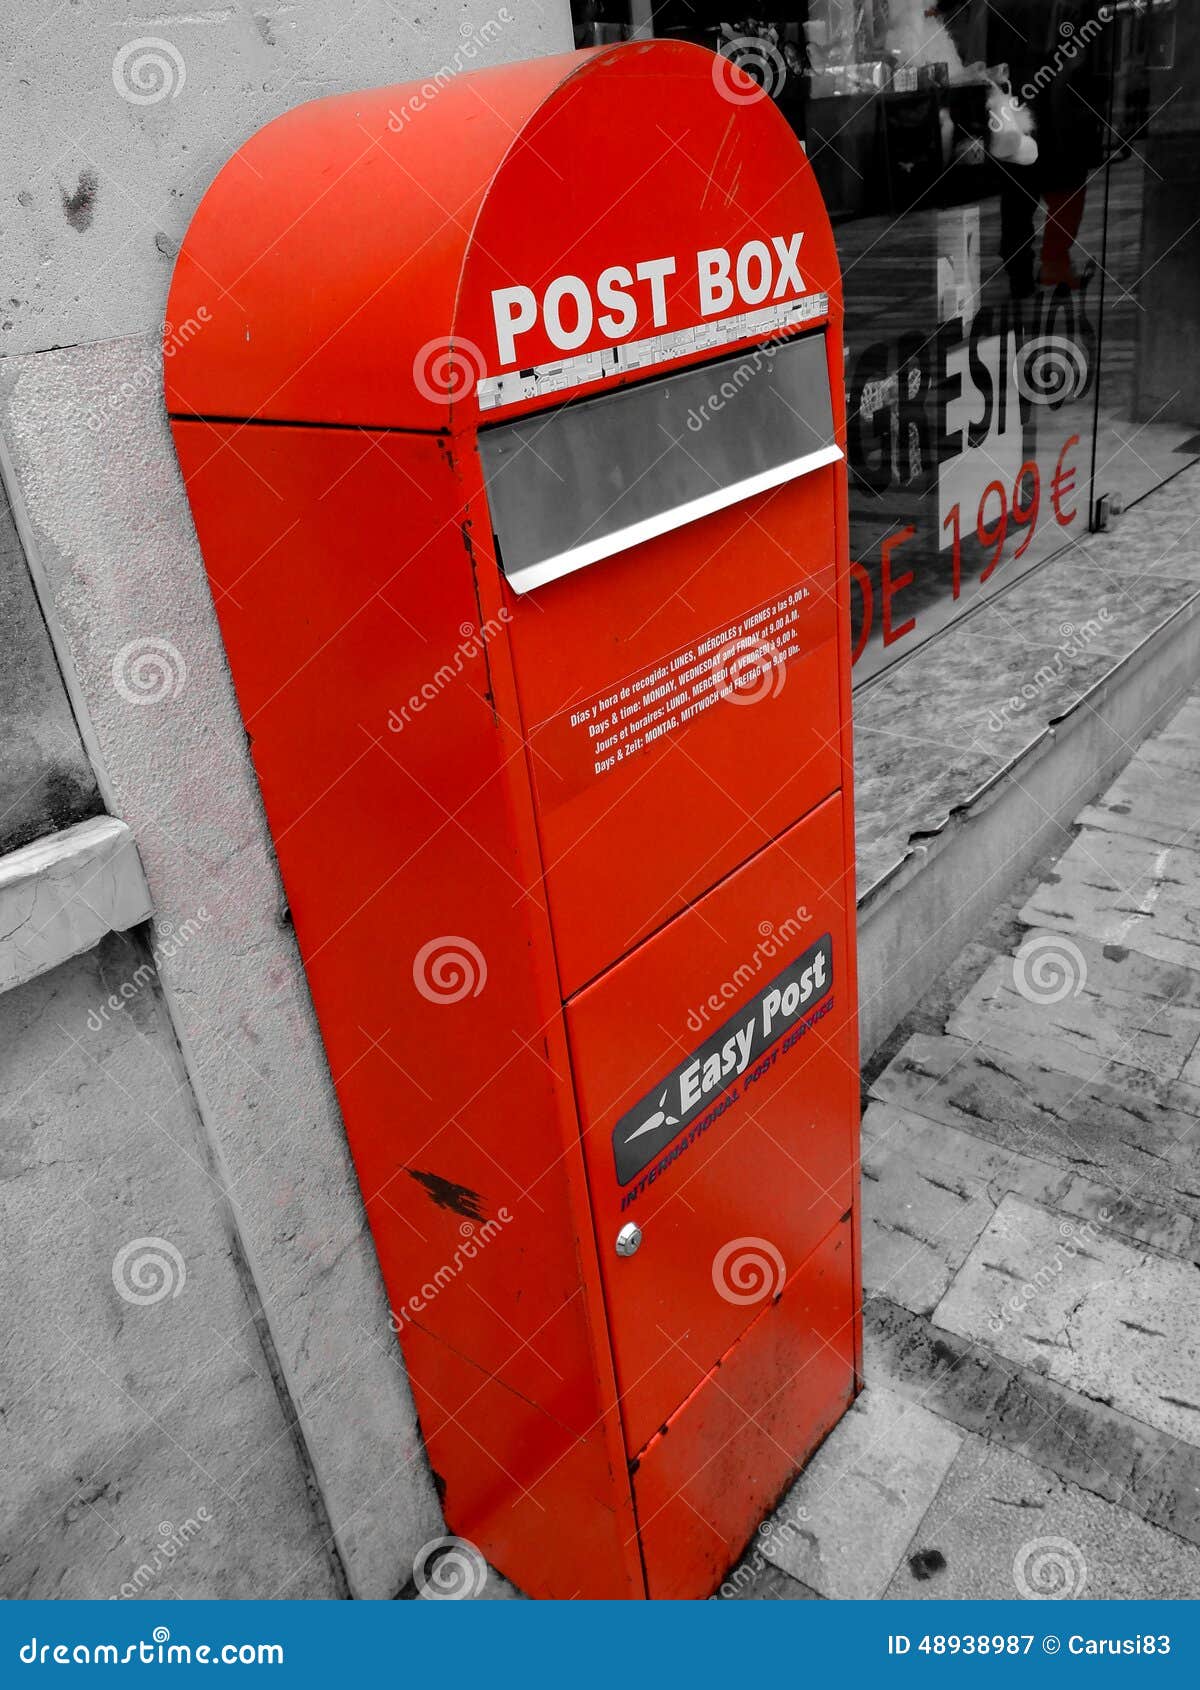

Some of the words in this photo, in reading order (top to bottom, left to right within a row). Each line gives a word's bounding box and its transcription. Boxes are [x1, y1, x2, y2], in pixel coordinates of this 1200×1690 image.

[491, 256, 676, 365] POST
[697, 232, 807, 316] BOX
[943, 434, 1081, 601] 199€
[570, 710, 590, 727] Días
[592, 705, 597, 718] y
[599, 694, 618, 712] hora
[620, 687, 631, 700] de
[632, 666, 669, 693] recogida:
[670, 650, 696, 672] LUNES,
[698, 626, 737, 656] MIÉRCOLES
[744, 607, 771, 630] VIERNES
[777, 599, 788, 613] las
[588, 720, 609, 738] Days
[611, 712, 618, 725] &
[620, 704, 641, 720] time:
[642, 679, 677, 707] MONDAY,
[678, 654, 721, 686] WEDNESDAY
[722, 645, 736, 660] and
[736, 631, 760, 652] FRIDAY
[761, 627, 769, 638] at
[594, 755, 615, 775] Days
[617, 749, 624, 761] &
[624, 738, 644, 756] Zeit:
[645, 716, 679, 744] MONTAG,
[680, 690, 719, 722] MITTWOCH
[720, 682, 733, 699] und
[734, 666, 761, 689] FREITAG
[595, 734, 618, 755] Jours
[620, 726, 629, 740] et
[630, 707, 665, 733] horaires:
[666, 691, 691, 712] LUNDI,
[692, 667, 728, 697] MERCREDI
[738, 642, 770, 669] VENDREDI
[680, 1018, 755, 1115] Easy
[762, 950, 825, 1038] Post
[621, 1089, 740, 1211] INTERNATIONAL
[744, 1049, 779, 1091] POST
[782, 997, 835, 1055] SERVICE
